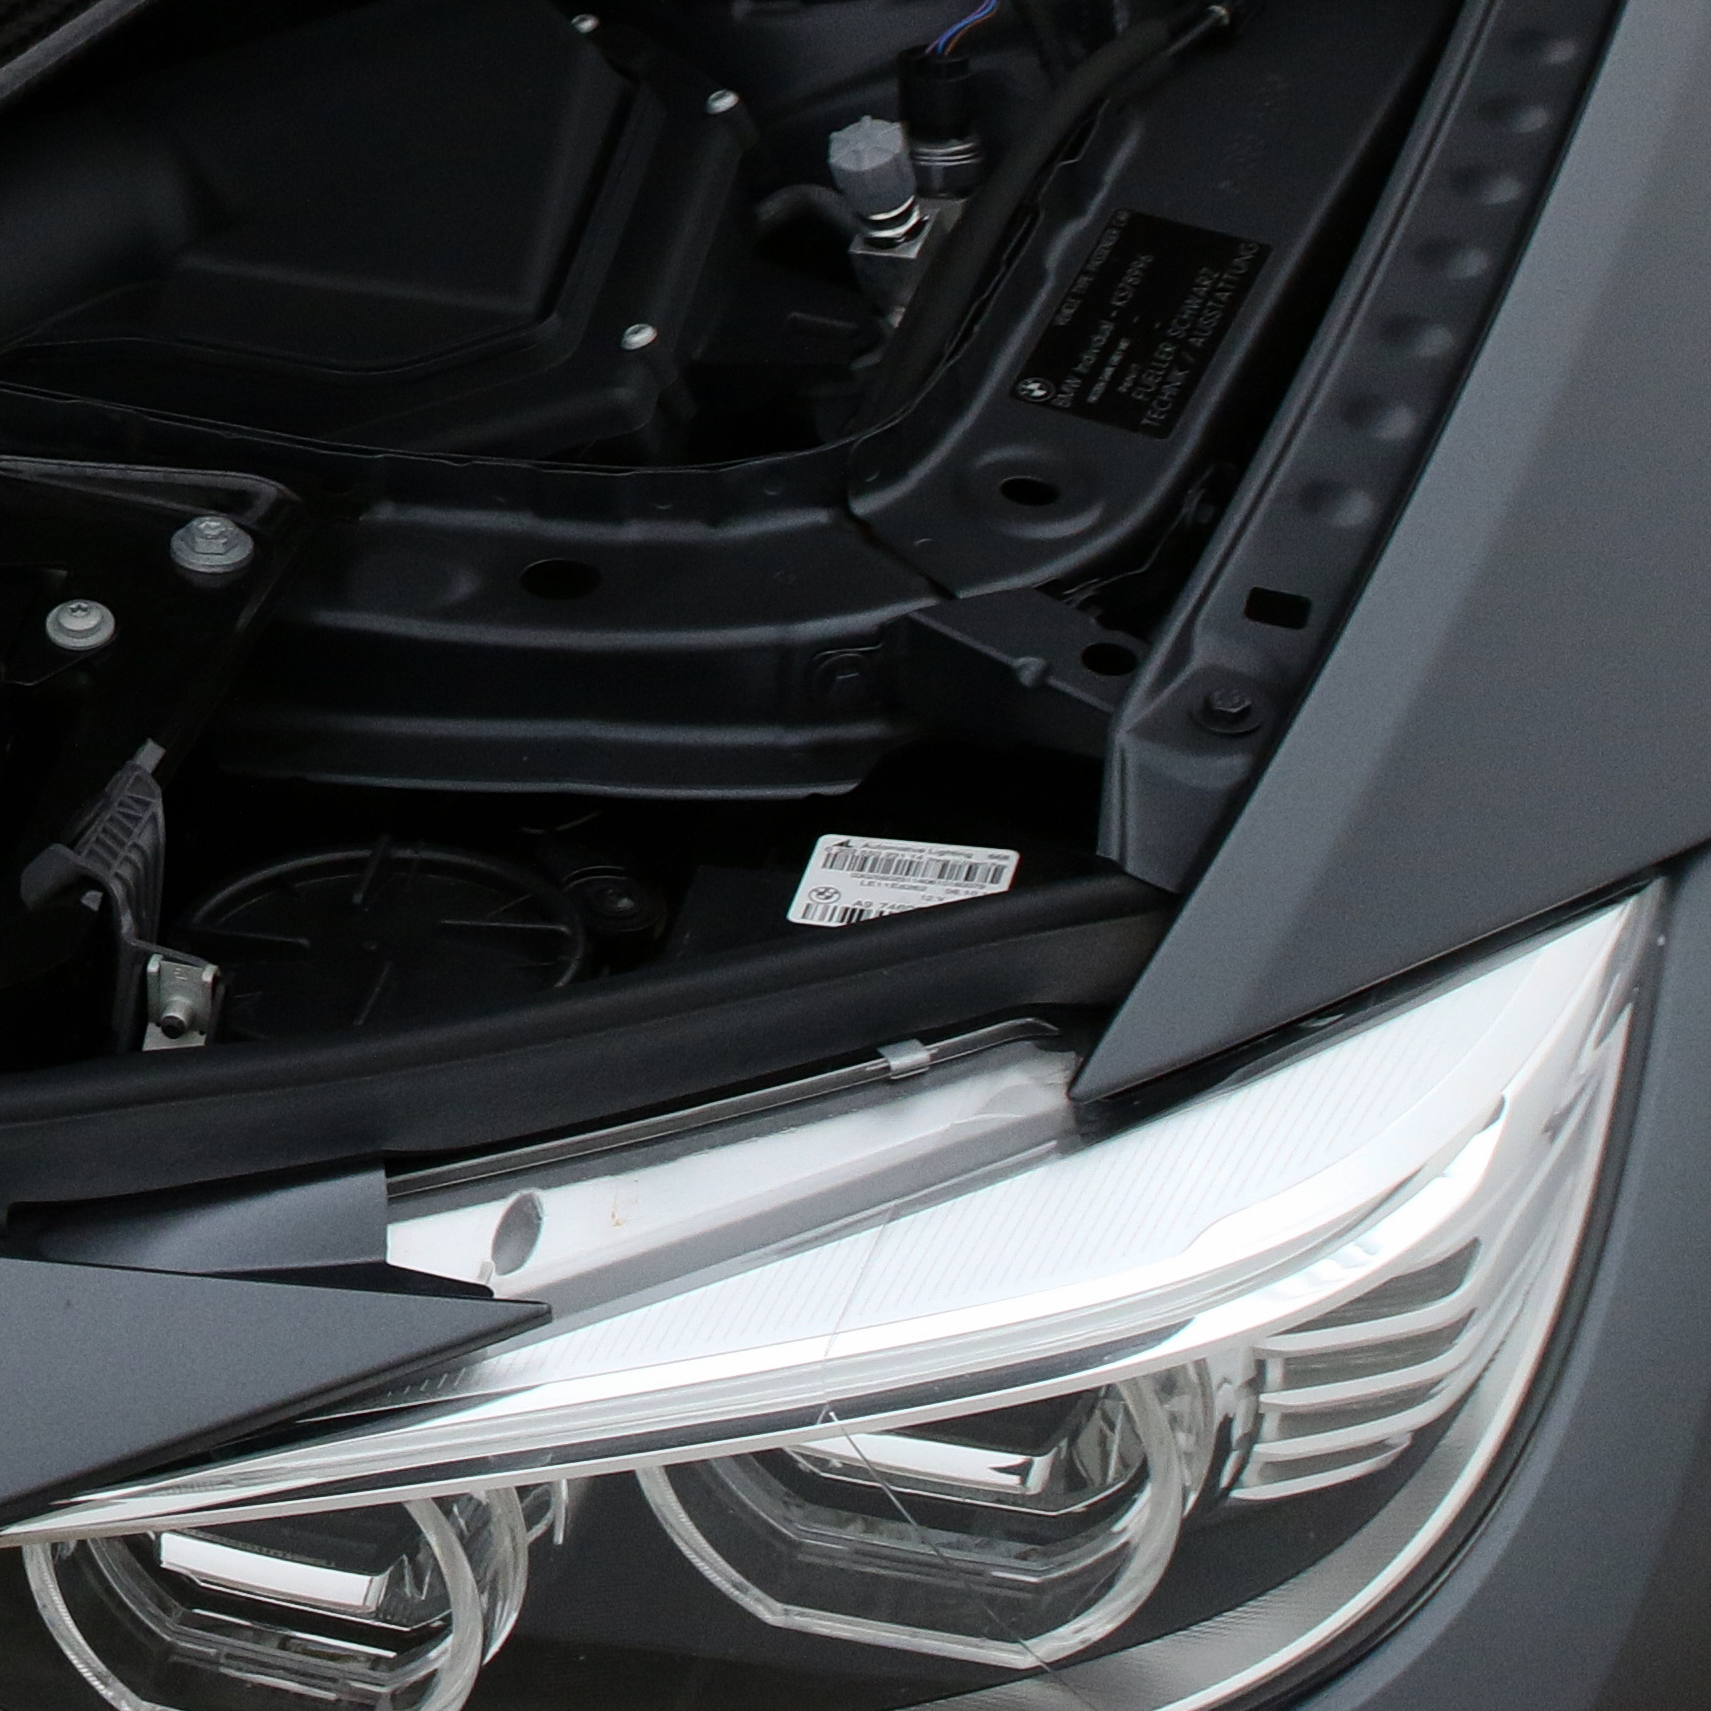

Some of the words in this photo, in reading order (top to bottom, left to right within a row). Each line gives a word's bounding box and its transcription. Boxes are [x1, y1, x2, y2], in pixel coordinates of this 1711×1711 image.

[1051, 374, 1084, 409] BMW
[1071, 318, 1115, 374] Individual
[1130, 341, 1179, 402] FUELLER
[1165, 266, 1221, 339] SCHWARZ
[1140, 365, 1190, 429] TECHNIK
[1186, 240, 1260, 348] AUSSTATTUNG
[928, 847, 974, 859] Lighting
